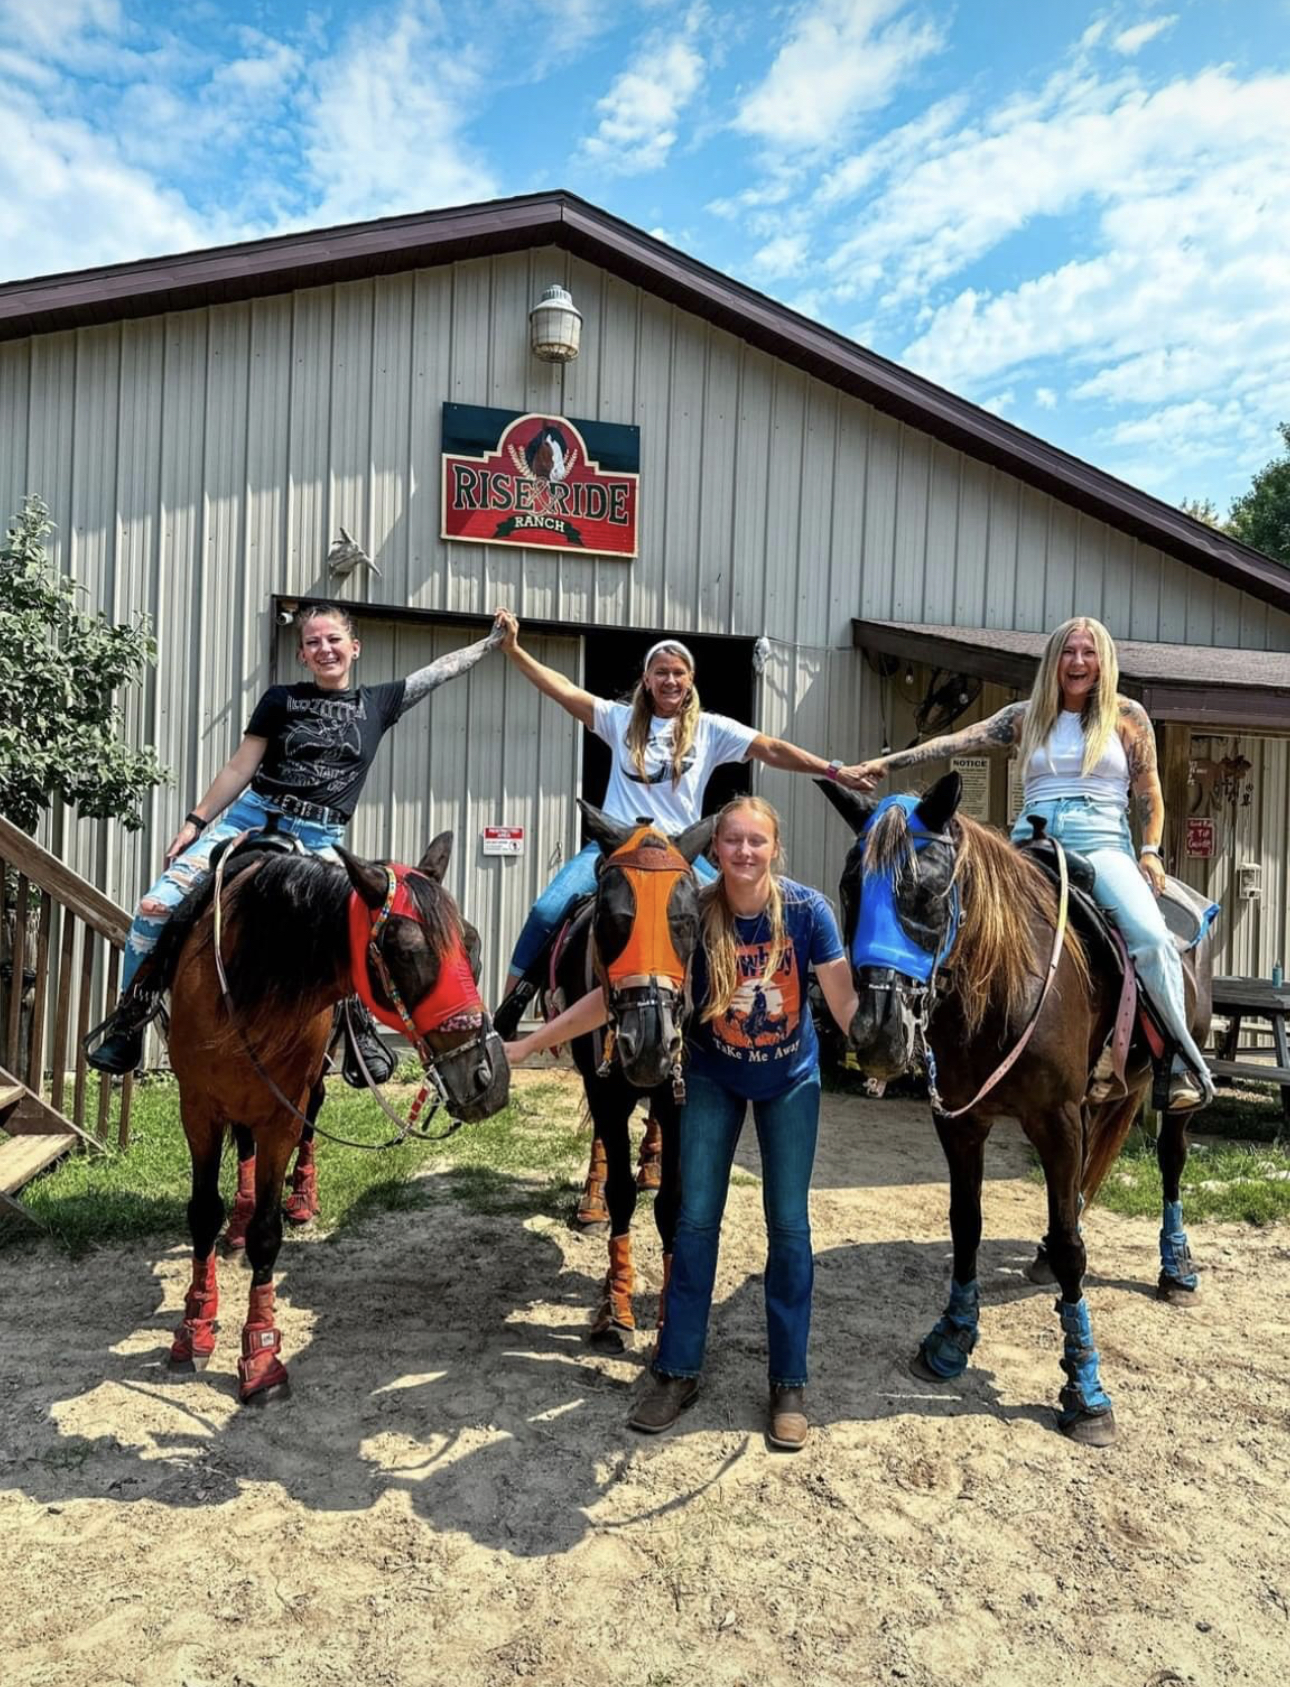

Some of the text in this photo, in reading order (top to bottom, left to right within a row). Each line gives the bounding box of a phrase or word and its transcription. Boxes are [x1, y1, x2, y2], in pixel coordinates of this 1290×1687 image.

[453, 464, 534, 511] RISE
[549, 482, 629, 526] RIDE
[514, 517, 565, 532] RANCH
[713, 1037, 800, 1063] Take Me Away
